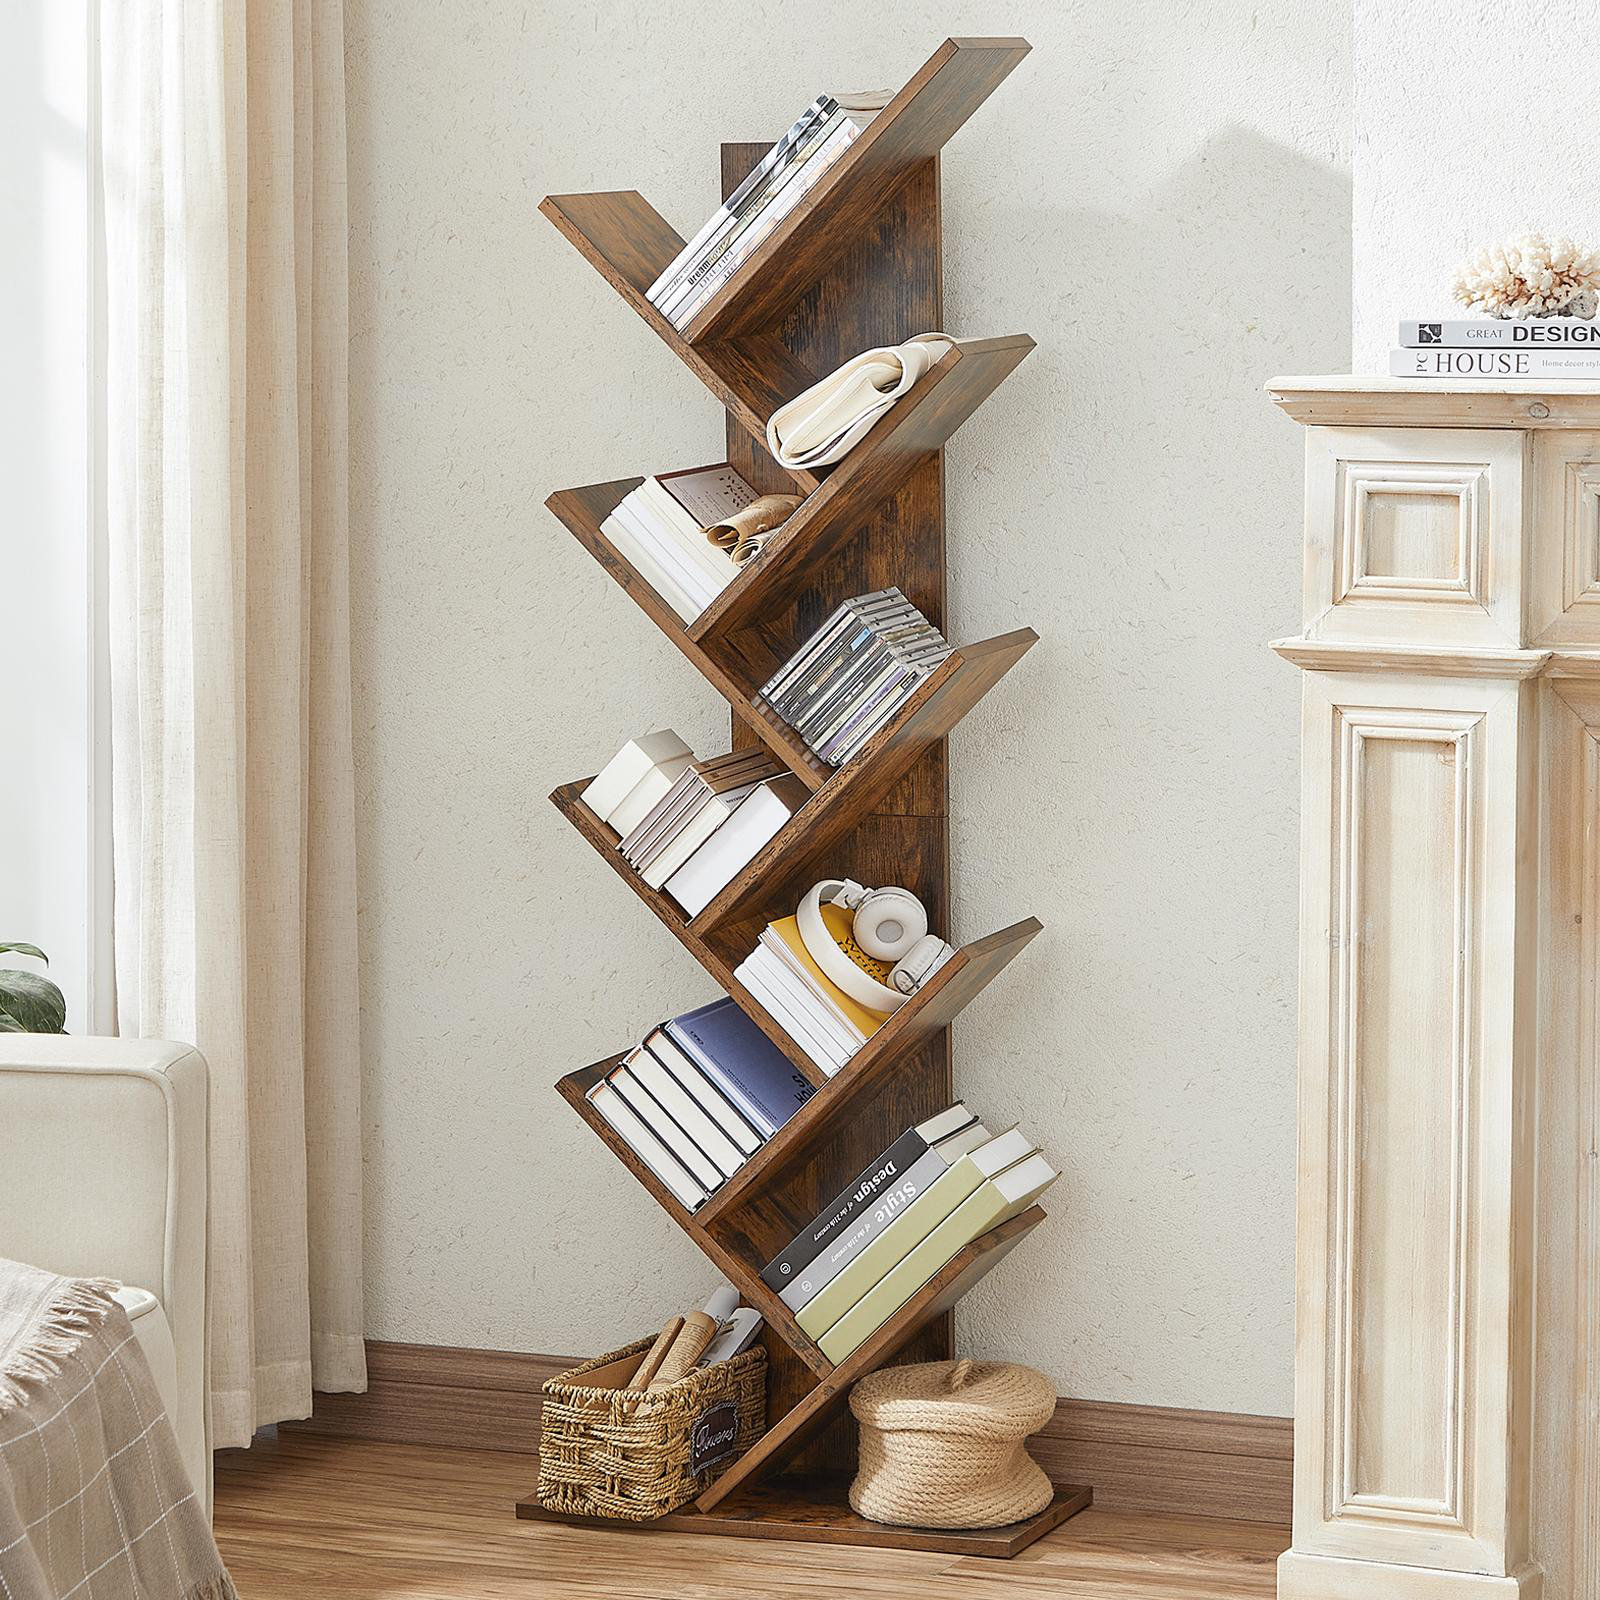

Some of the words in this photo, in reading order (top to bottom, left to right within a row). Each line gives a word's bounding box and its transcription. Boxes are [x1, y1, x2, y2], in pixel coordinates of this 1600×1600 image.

[1467, 329, 1504, 339] GREAT
[1416, 353, 1429, 372] PC
[1436, 352, 1530, 374] HOUSE
[852, 1160, 896, 1202] Design
[847, 1200, 853, 1211] of
[873, 1180, 916, 1222] Style
[838, 1206, 848, 1216] the
[813, 1222, 830, 1241] century
[864, 1223, 870, 1233] of
[831, 1245, 847, 1263] century
